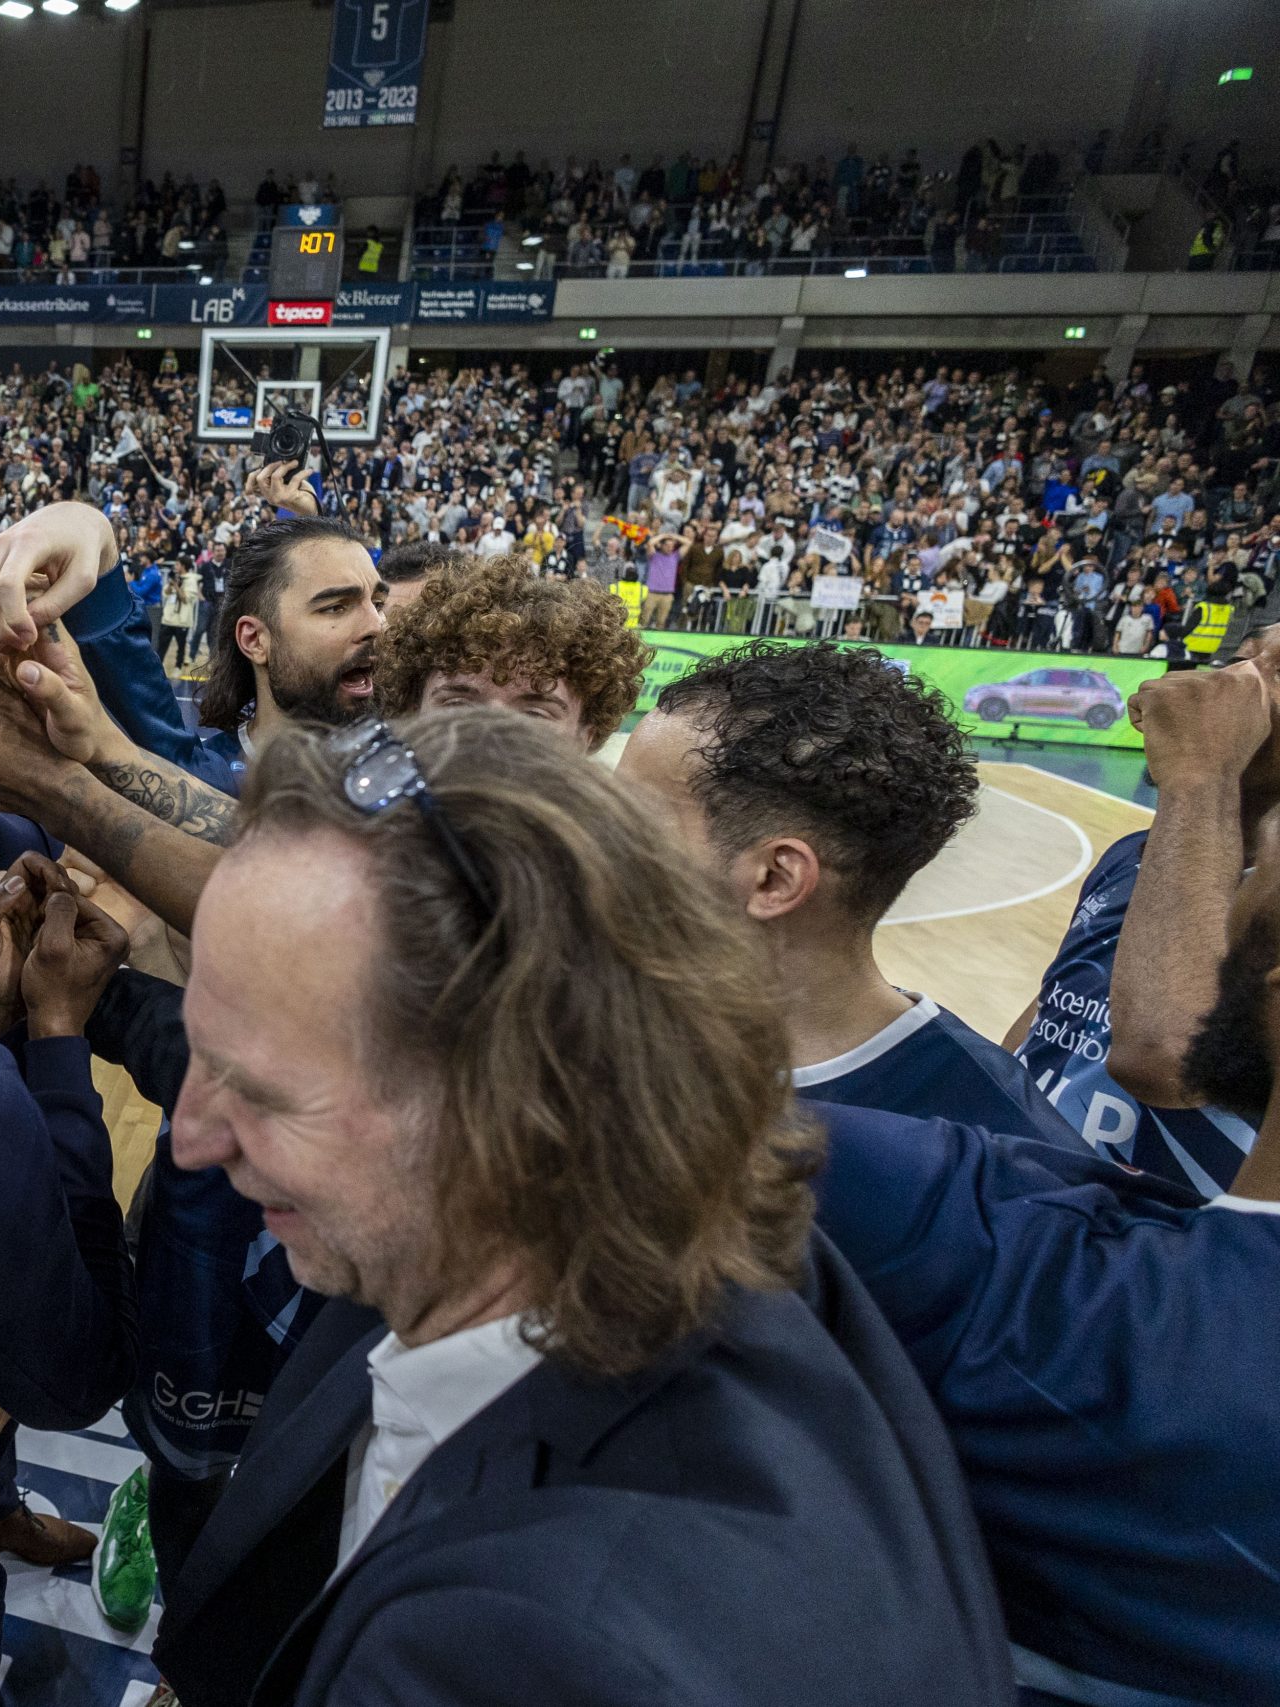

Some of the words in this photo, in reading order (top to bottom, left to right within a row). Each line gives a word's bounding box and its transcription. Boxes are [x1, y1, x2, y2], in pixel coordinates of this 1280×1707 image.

[371, 3, 390, 41] 5
[325, 88, 364, 111] 2013
[378, 85, 418, 109] 2023
[190, 298, 235, 323] LAB
[275, 303, 325, 322] tipico
[155, 1371, 244, 1420] GGH
